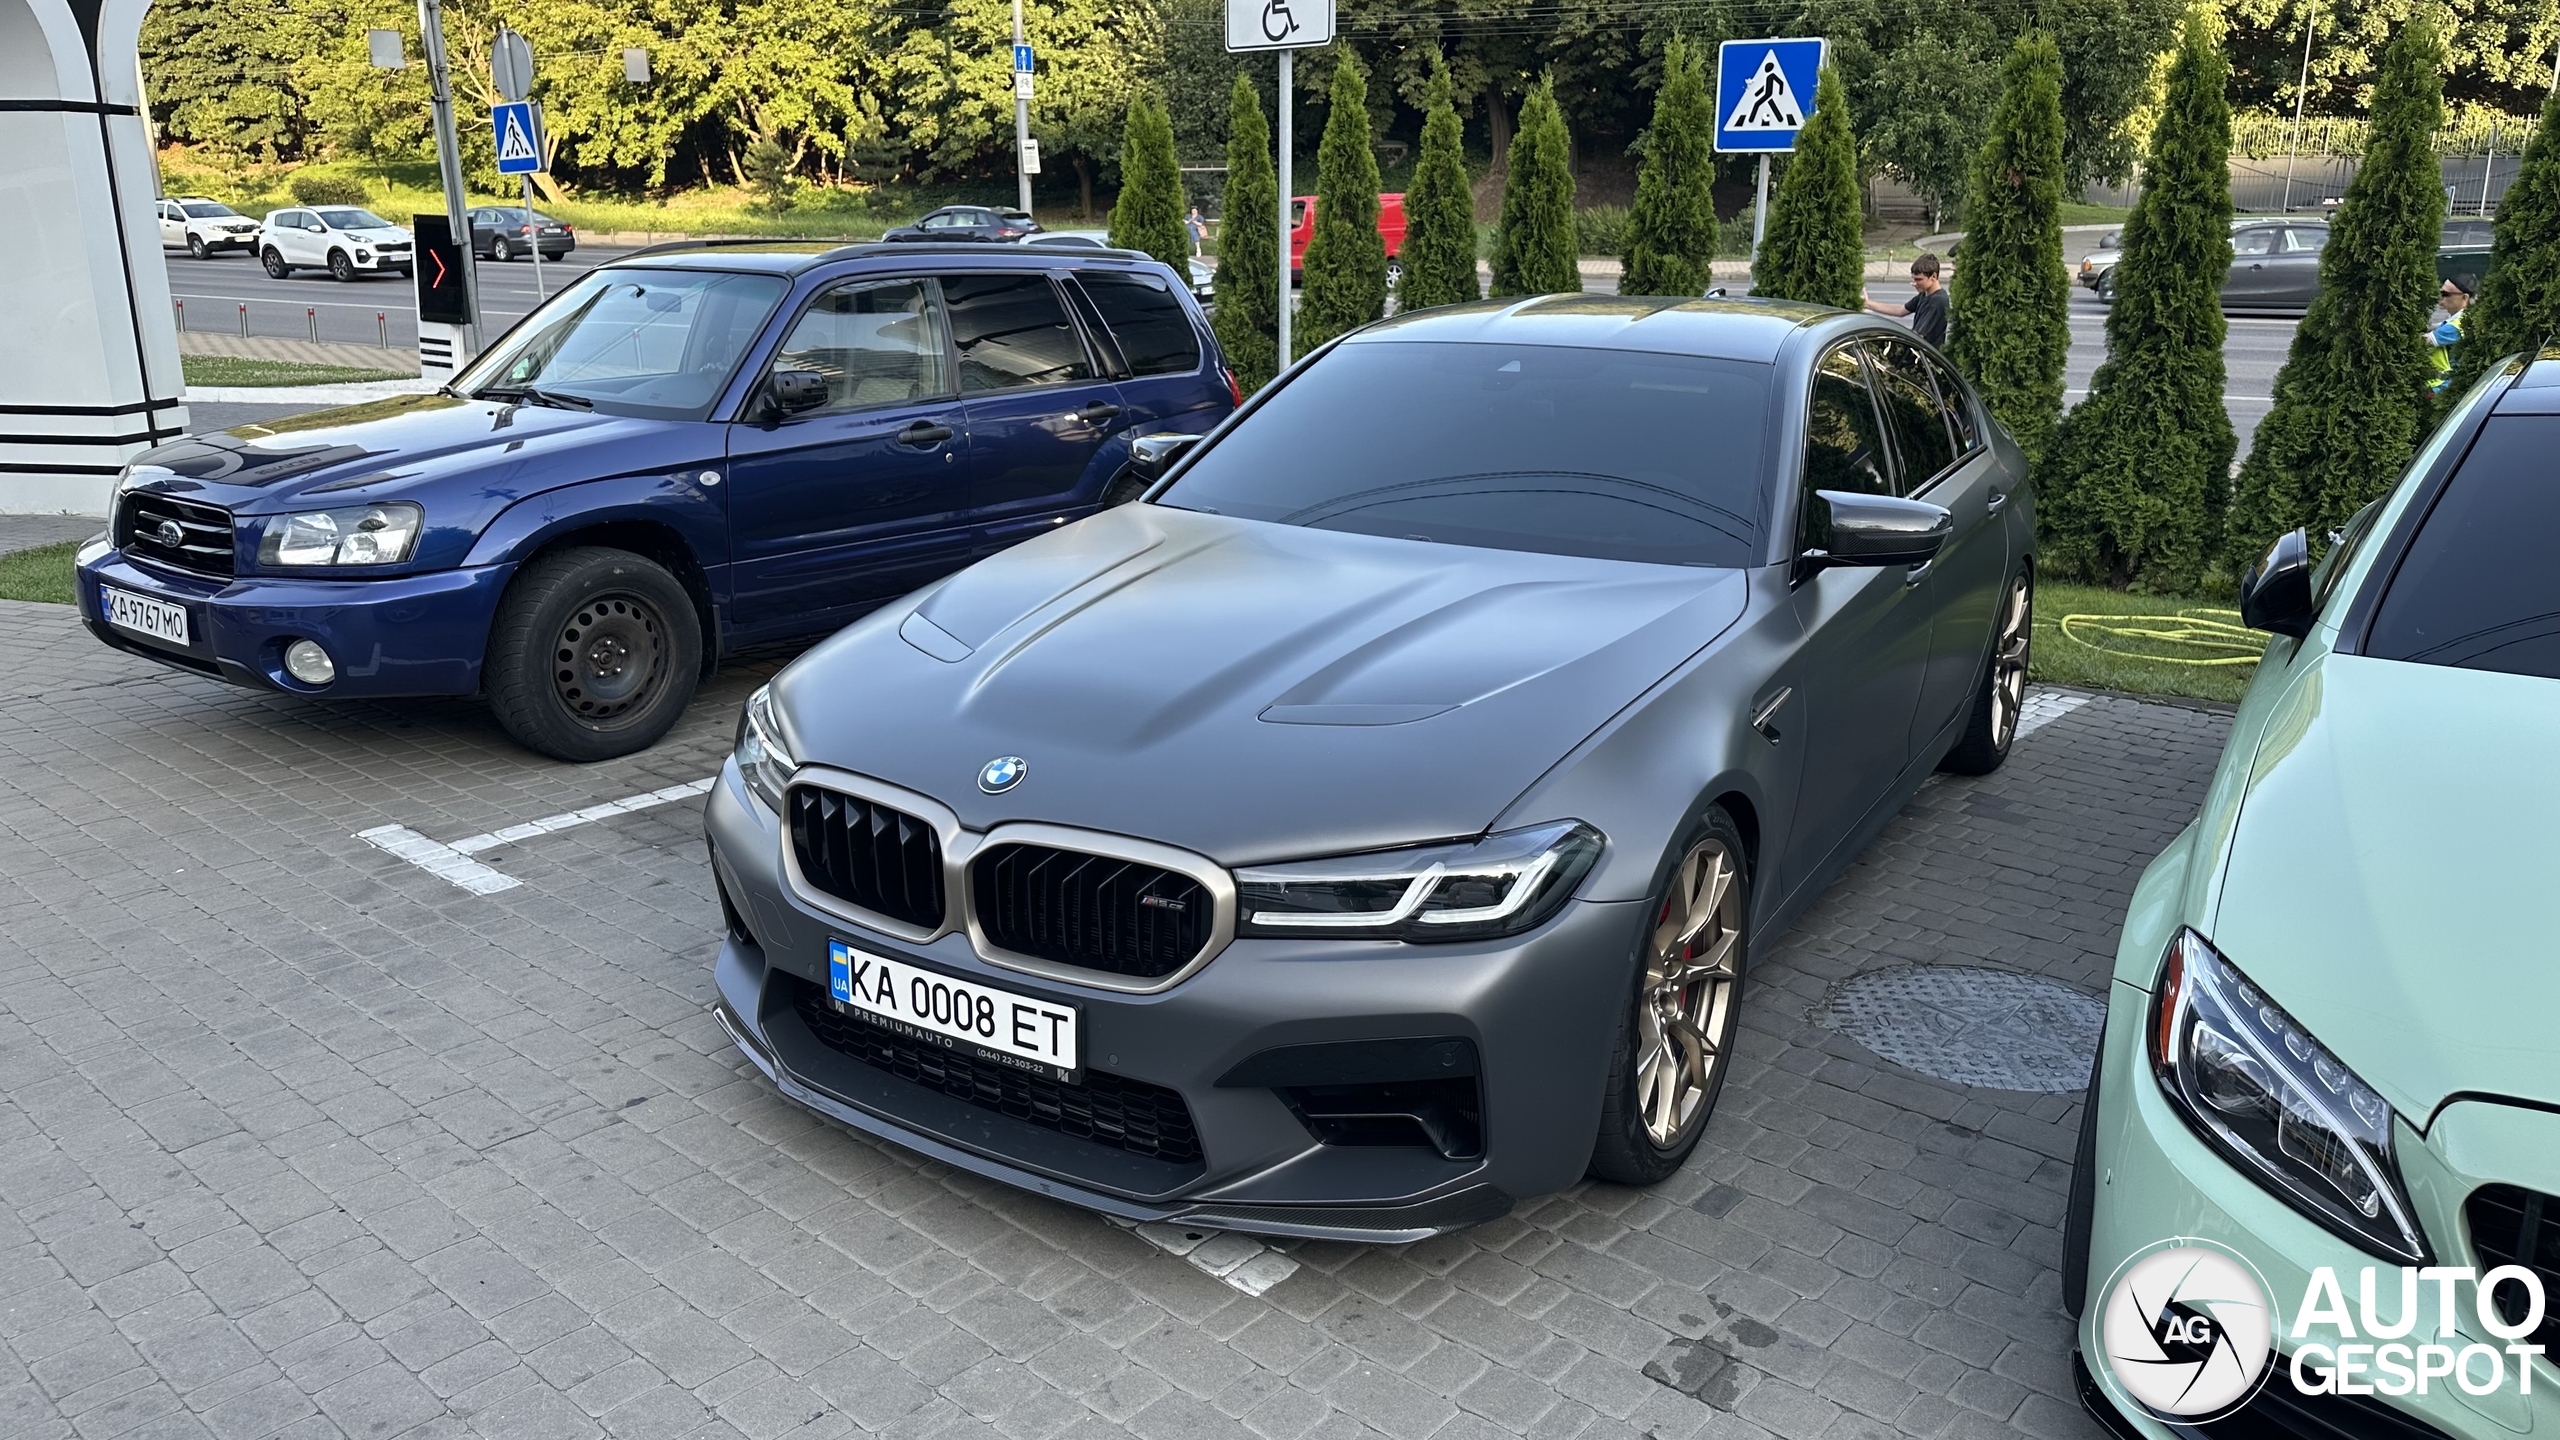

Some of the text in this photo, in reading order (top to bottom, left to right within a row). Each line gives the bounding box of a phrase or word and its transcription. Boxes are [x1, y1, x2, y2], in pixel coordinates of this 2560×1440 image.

[833, 976, 848, 993] UA
[850, 955, 1068, 1057] KA 0008 ET
[854, 1008, 953, 1048] PREMIUMAUTO
[977, 1048, 1044, 1073] (044) 22-303-22
